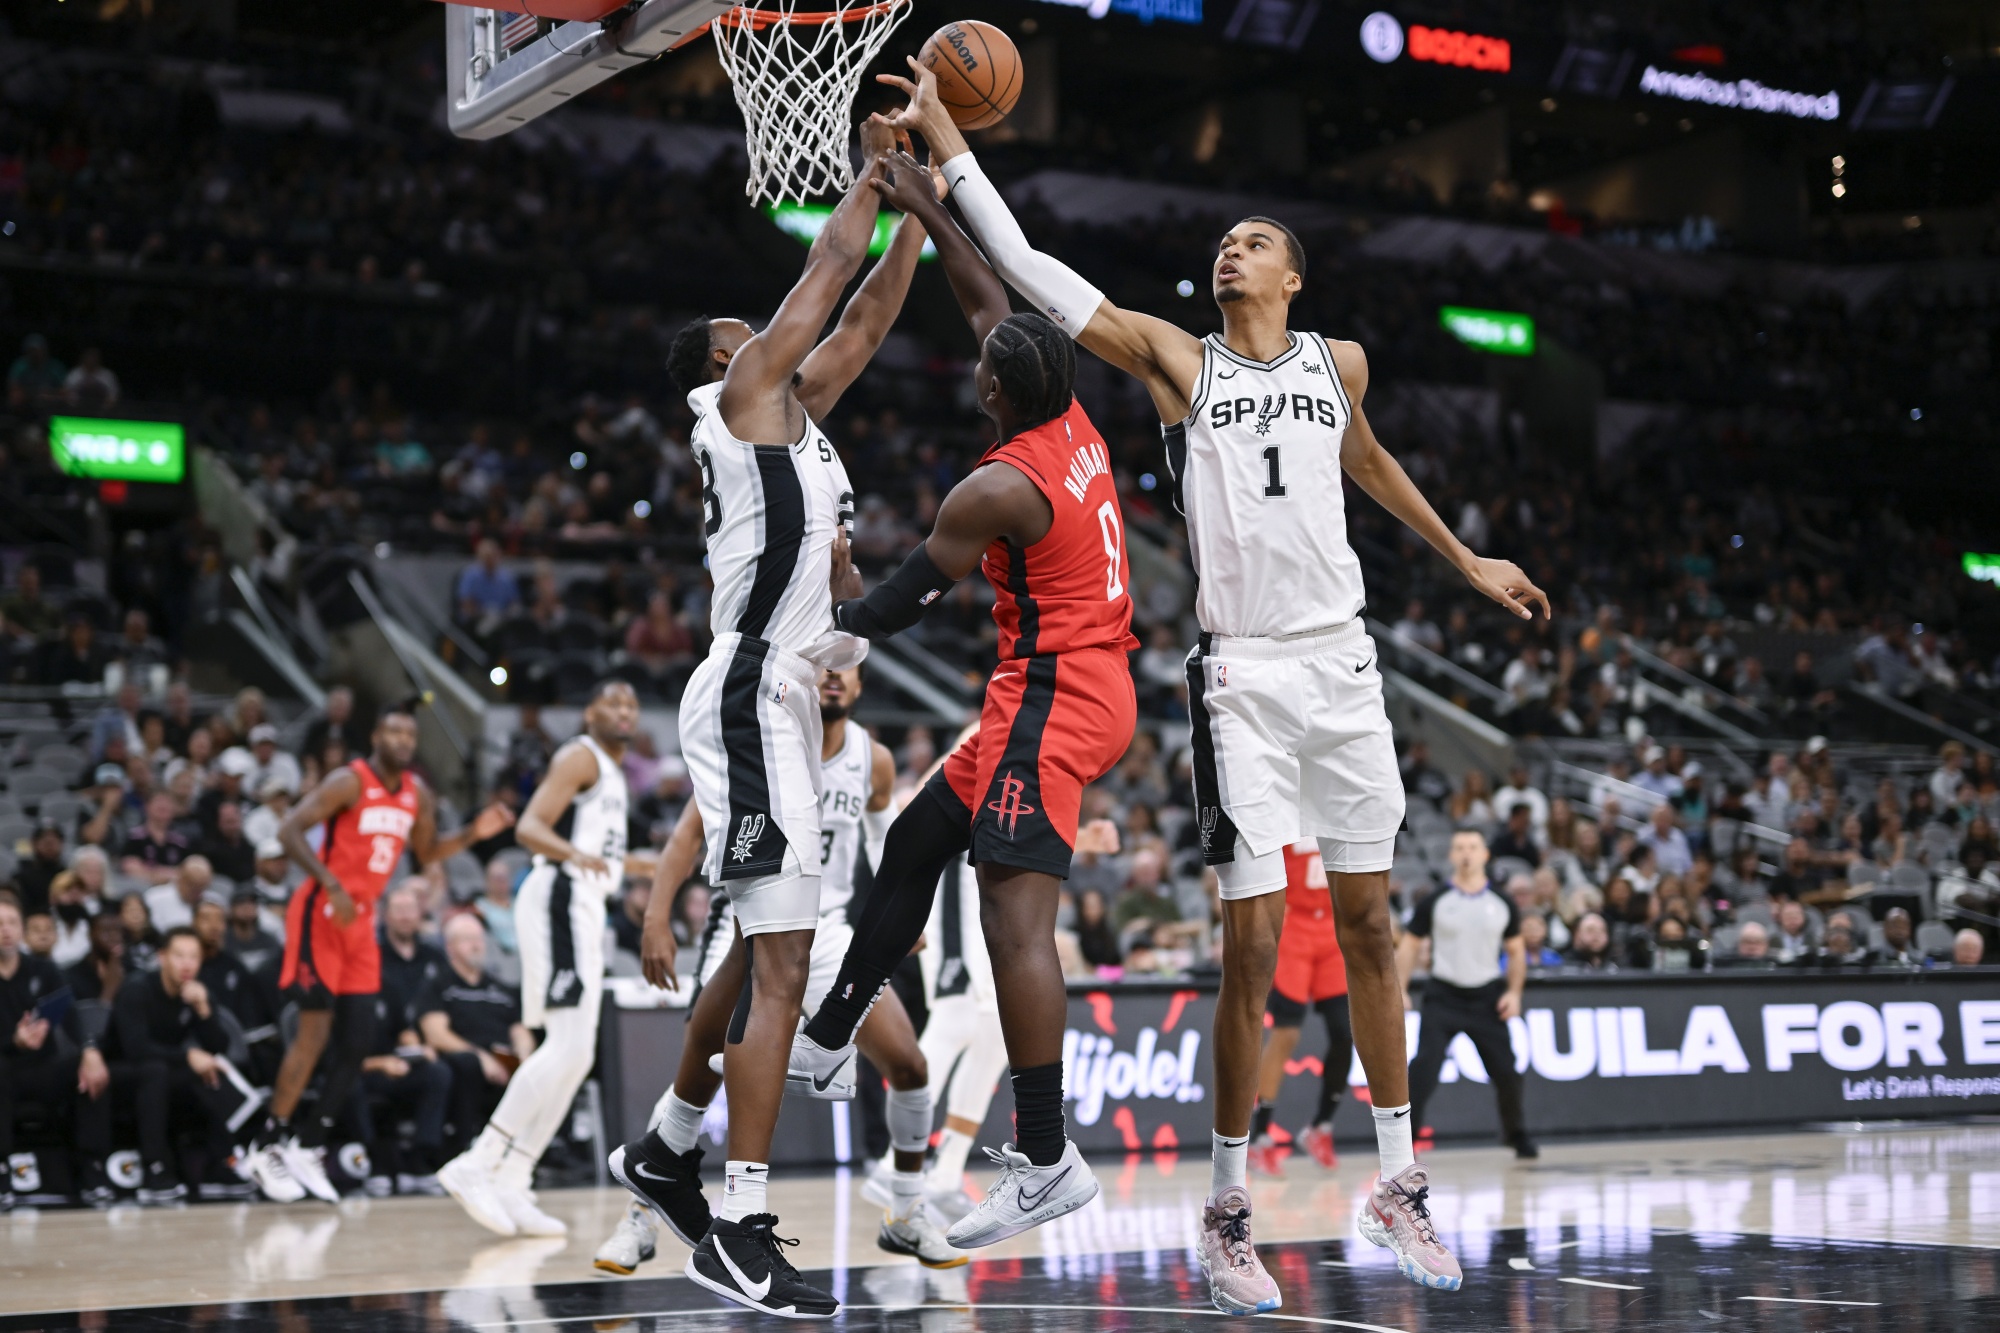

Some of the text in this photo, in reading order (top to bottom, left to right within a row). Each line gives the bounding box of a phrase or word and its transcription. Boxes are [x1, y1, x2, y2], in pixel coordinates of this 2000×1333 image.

[1408, 25, 1511, 74] BOSCH
[1301, 361, 1326, 376] Self.
[1210, 392, 1336, 438] SPURS
[1260, 444, 1288, 500] 1
[1097, 500, 1124, 602] 0
[1348, 1007, 1751, 1086] UILA
[1761, 1000, 1949, 1072] FOR
[1842, 1076, 1885, 1101] Let's
[1885, 1075, 1931, 1099] Drink
